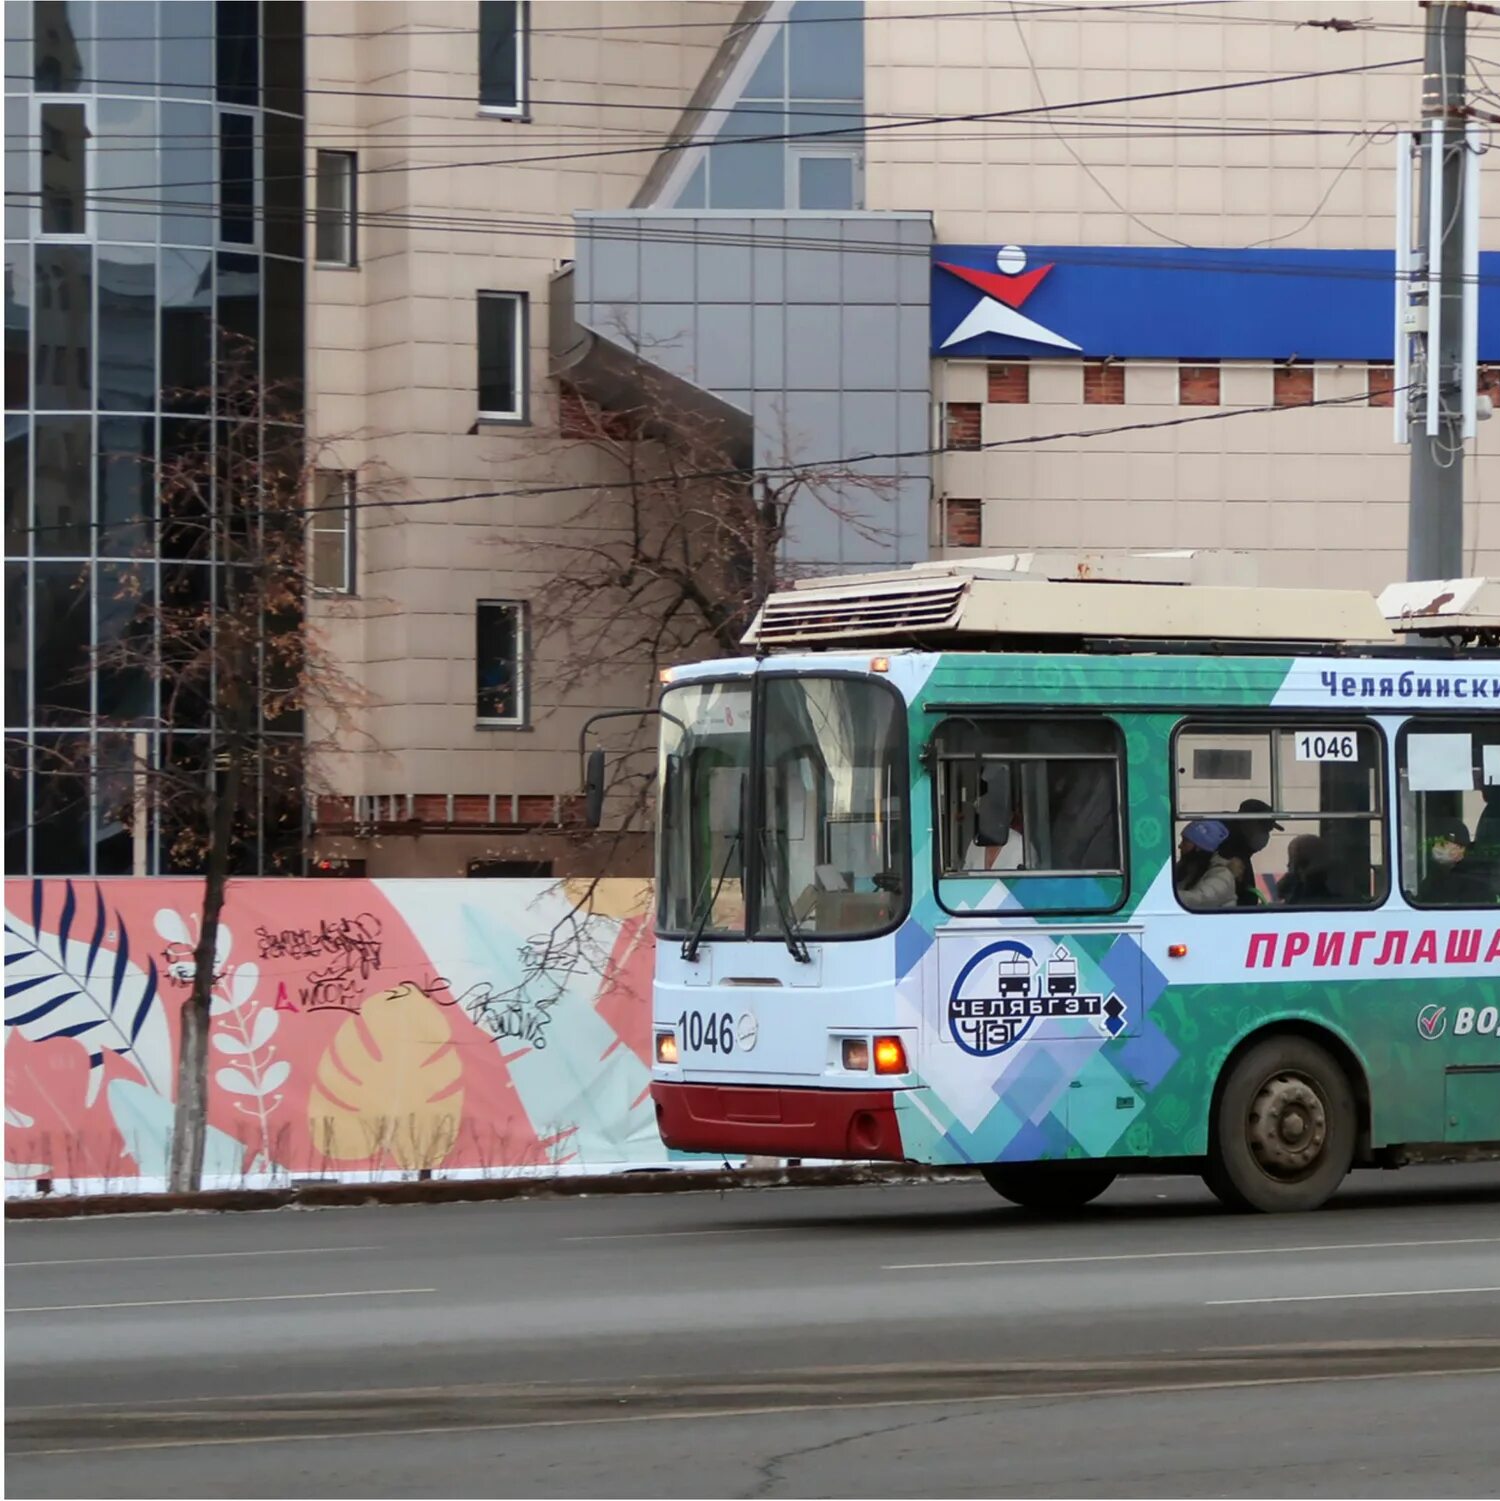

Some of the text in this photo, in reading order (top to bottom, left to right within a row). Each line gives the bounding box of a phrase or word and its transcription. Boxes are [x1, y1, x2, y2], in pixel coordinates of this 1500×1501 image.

[1301, 736, 1353, 758] 1046
[952, 998, 1098, 1016] ЧЕЛЯБГЭТ
[678, 1010, 733, 1055] 1046
